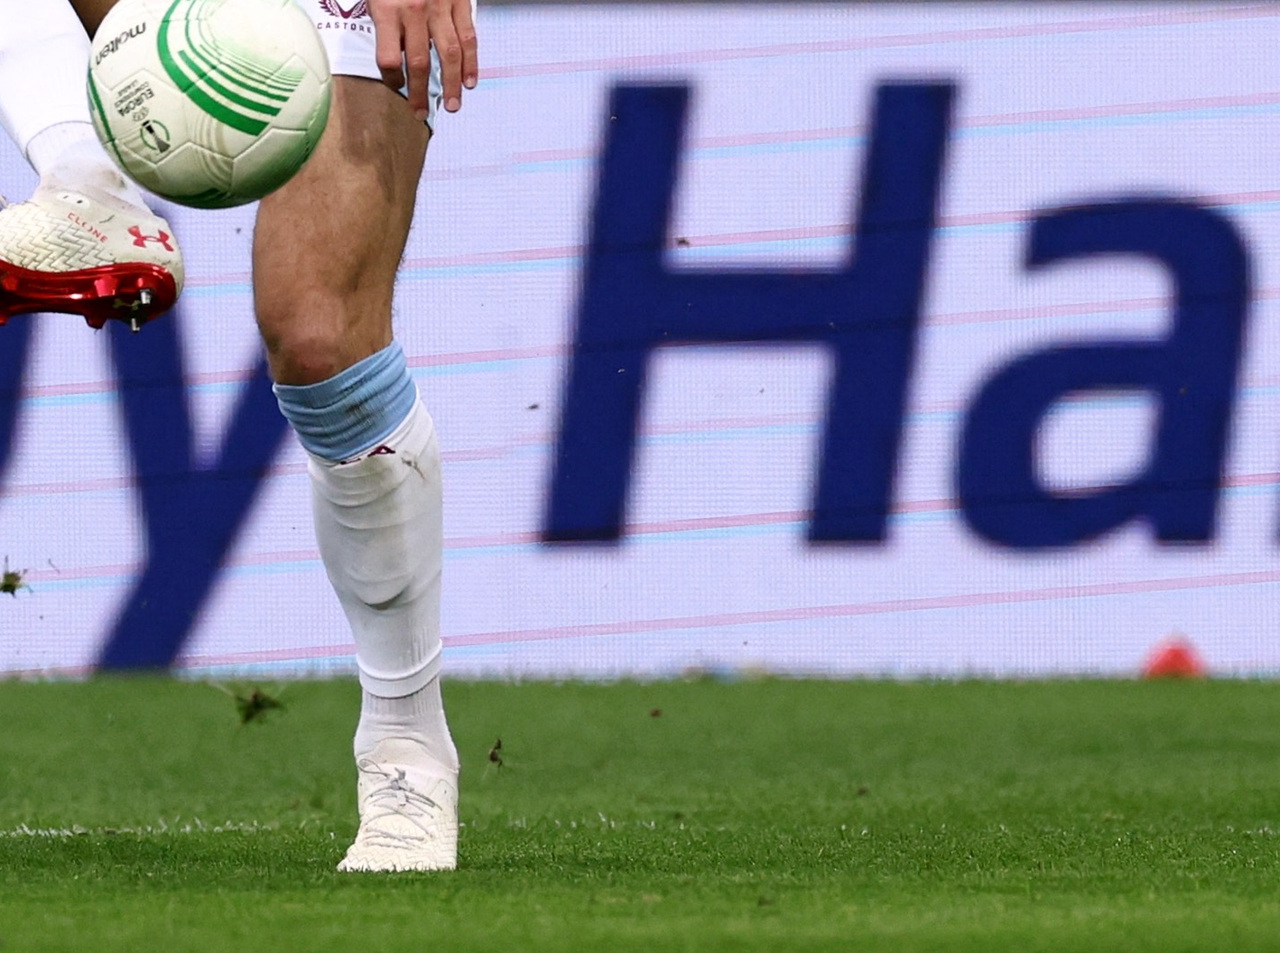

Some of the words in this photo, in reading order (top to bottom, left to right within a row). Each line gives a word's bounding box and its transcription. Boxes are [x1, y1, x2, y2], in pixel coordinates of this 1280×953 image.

[317, 22, 372, 34] CASTORE
[95, 22, 147, 66] molten
[117, 88, 155, 117] EUROPA
[67, 212, 108, 244] CLONE
